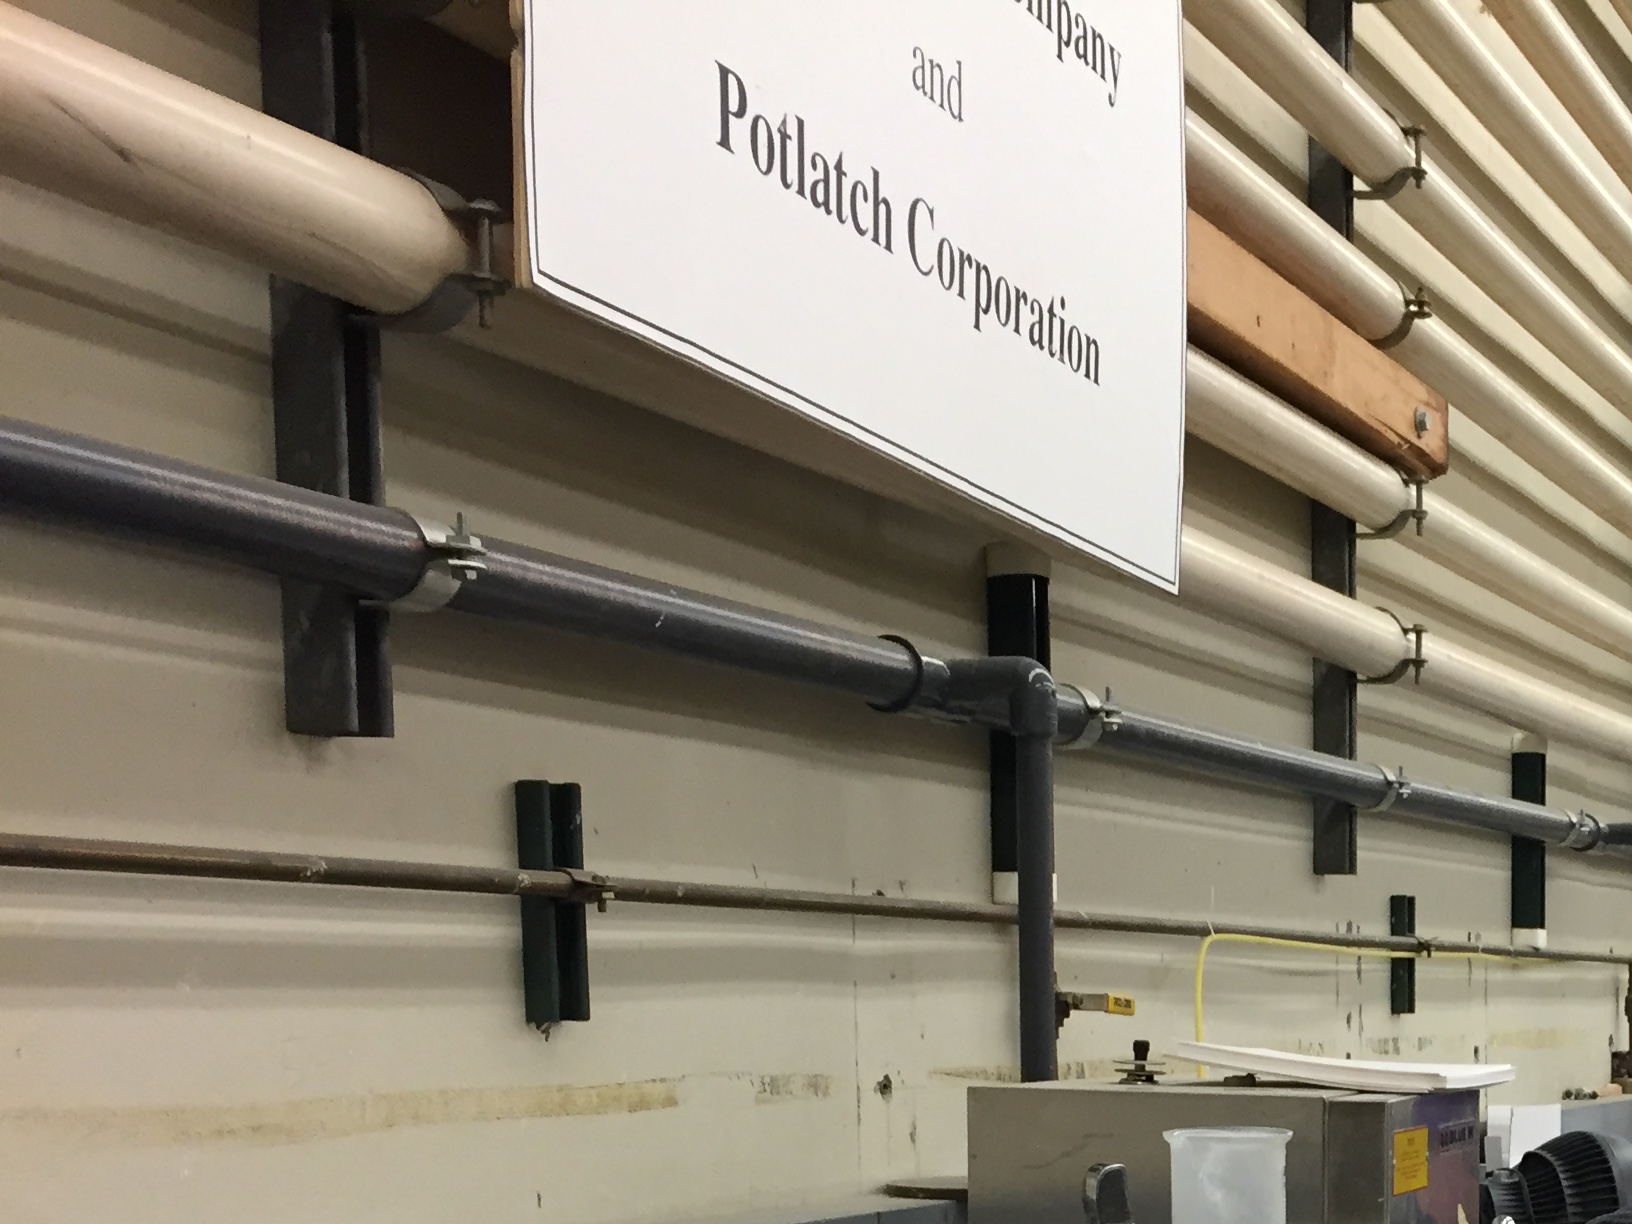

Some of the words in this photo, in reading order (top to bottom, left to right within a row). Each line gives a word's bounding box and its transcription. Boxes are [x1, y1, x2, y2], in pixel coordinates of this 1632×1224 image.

[912, 45, 964, 123] and
[714, 59, 894, 255] Potlatch
[908, 197, 1101, 387] Corporation
